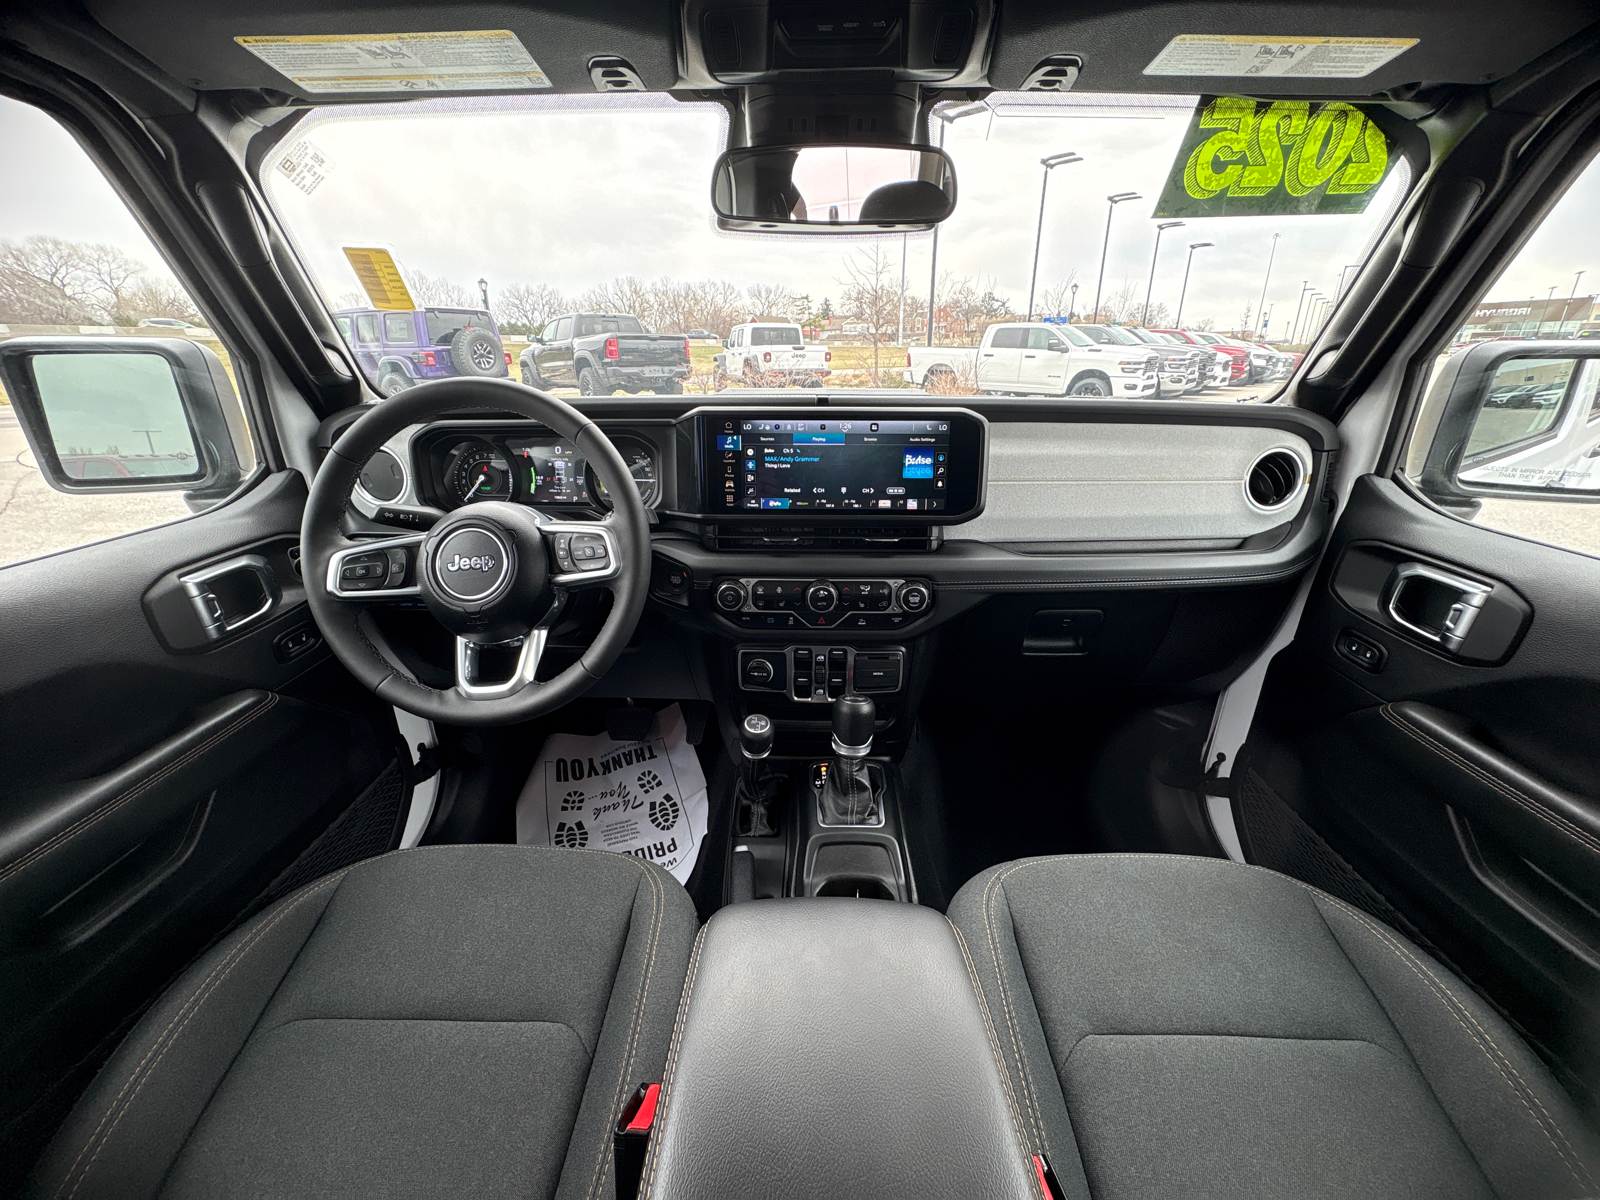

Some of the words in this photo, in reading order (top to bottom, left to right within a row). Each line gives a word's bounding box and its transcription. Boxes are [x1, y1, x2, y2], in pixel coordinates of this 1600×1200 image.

[1474, 307, 1532, 317] HYUNDAI
[554, 446, 562, 455] 0
[905, 455, 932, 466] pulse
[1479, 465, 1509, 473] OBJECTS
[1520, 467, 1545, 475] MIRROR
[1564, 470, 1592, 479] CLOSER
[1498, 471, 1516, 479] THAN
[447, 554, 495, 572] Jeep
[593, 795, 644, 821] Thank
